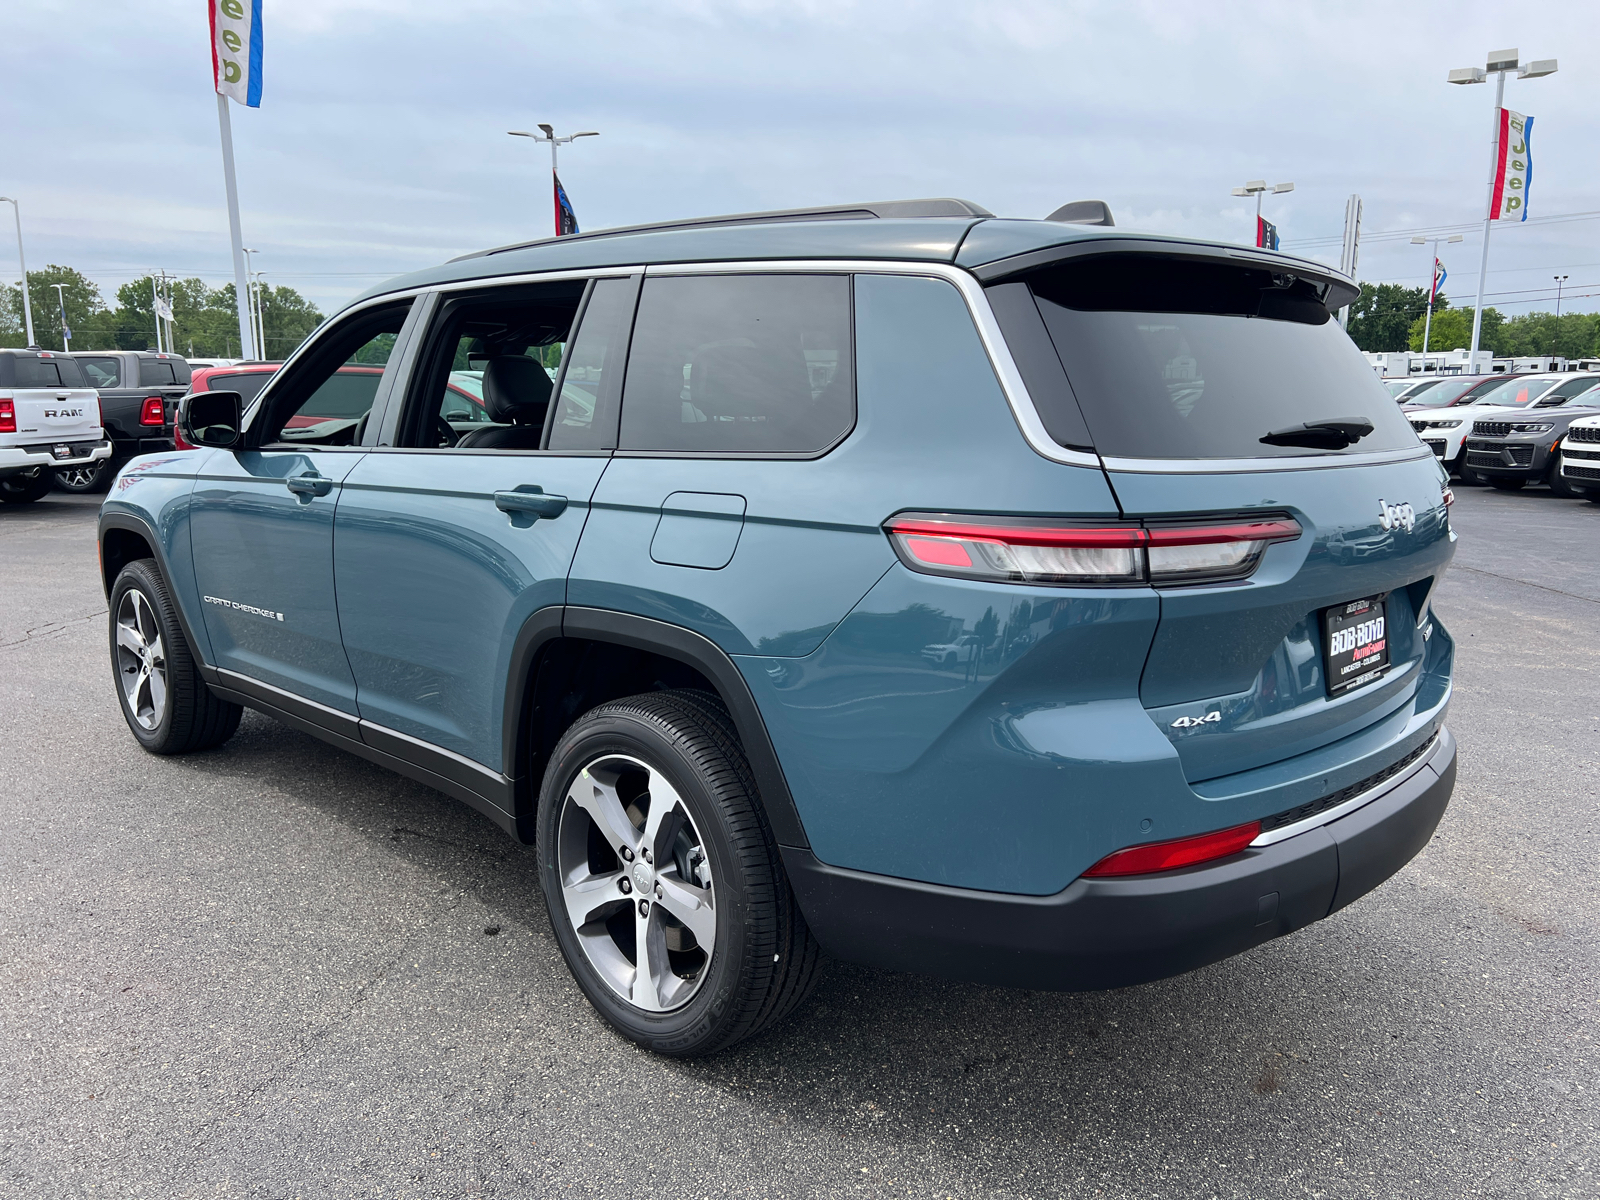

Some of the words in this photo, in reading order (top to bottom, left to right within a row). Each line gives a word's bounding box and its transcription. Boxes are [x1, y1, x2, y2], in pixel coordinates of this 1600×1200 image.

[1505, 138, 1526, 213] Jeep
[44, 409, 84, 418] RAM
[1378, 498, 1416, 534] Jeep
[203, 595, 231, 608] GRAND
[231, 601, 276, 619] CHEROKEE
[1170, 710, 1222, 728] 4x4
